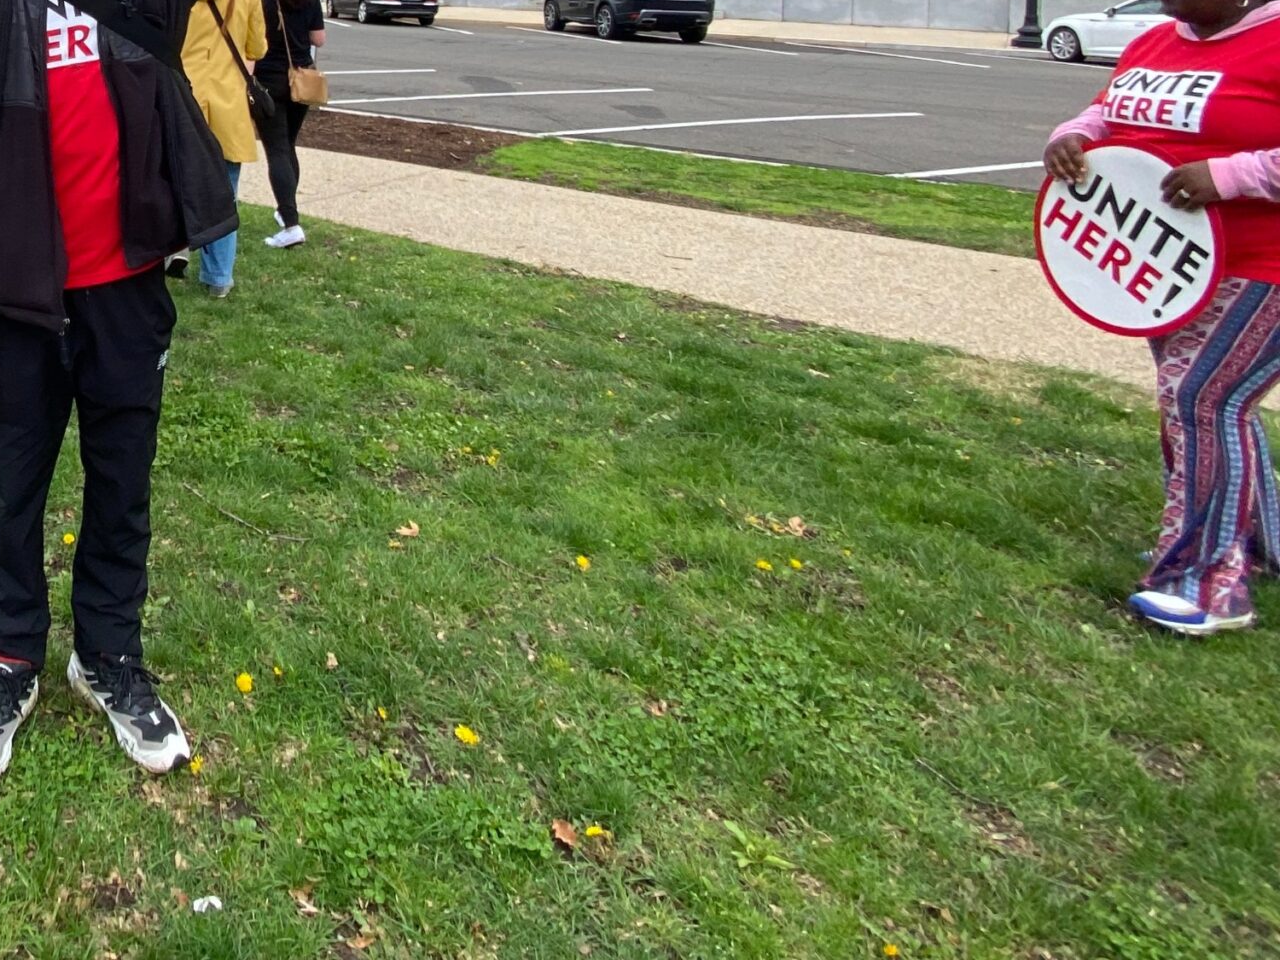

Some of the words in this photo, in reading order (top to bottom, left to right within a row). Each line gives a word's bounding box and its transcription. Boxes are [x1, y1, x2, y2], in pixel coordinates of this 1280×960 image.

[45, 24, 94, 64] ER
[1113, 70, 1215, 98] UNITE
[1102, 94, 1195, 128] HERE!
[1067, 174, 1210, 285] UNITE
[1043, 197, 1183, 319] HERE!
